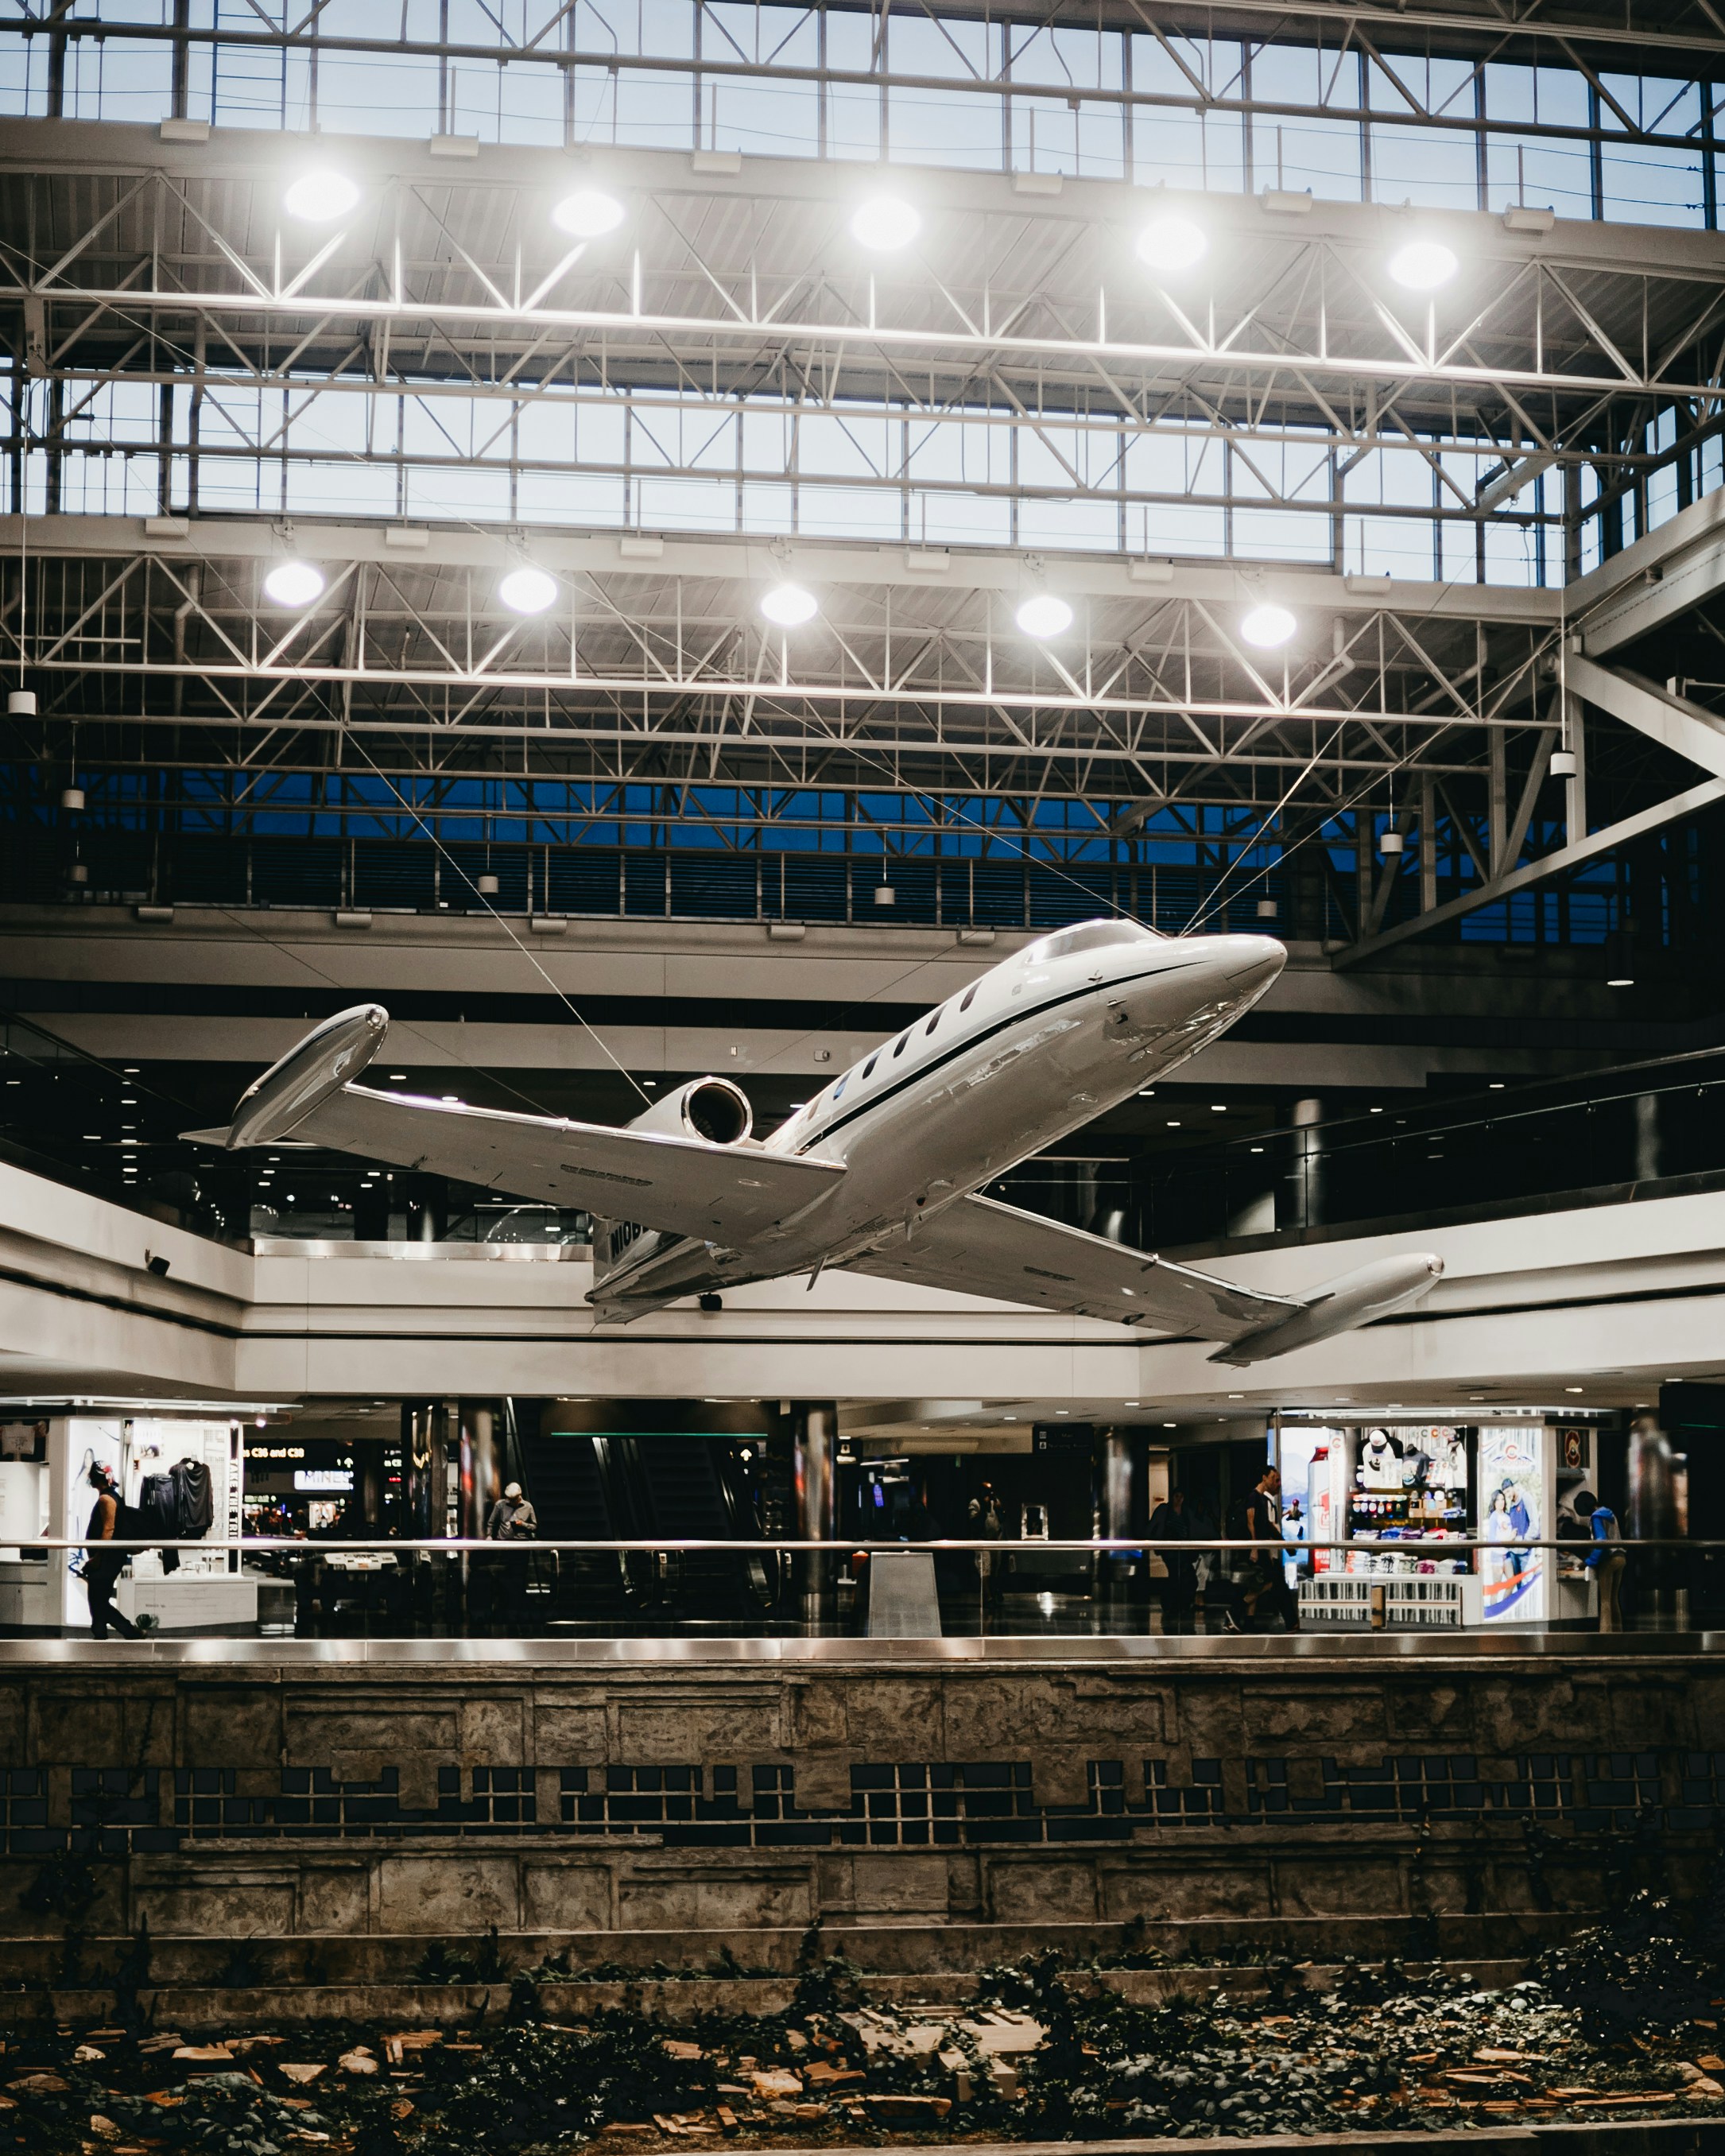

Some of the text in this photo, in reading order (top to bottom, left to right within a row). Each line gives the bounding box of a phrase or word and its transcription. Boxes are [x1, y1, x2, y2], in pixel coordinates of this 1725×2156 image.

[269, 1448, 287, 1457] and
[229, 1458, 238, 1487] TAKE
[229, 1491, 238, 1513] THE
